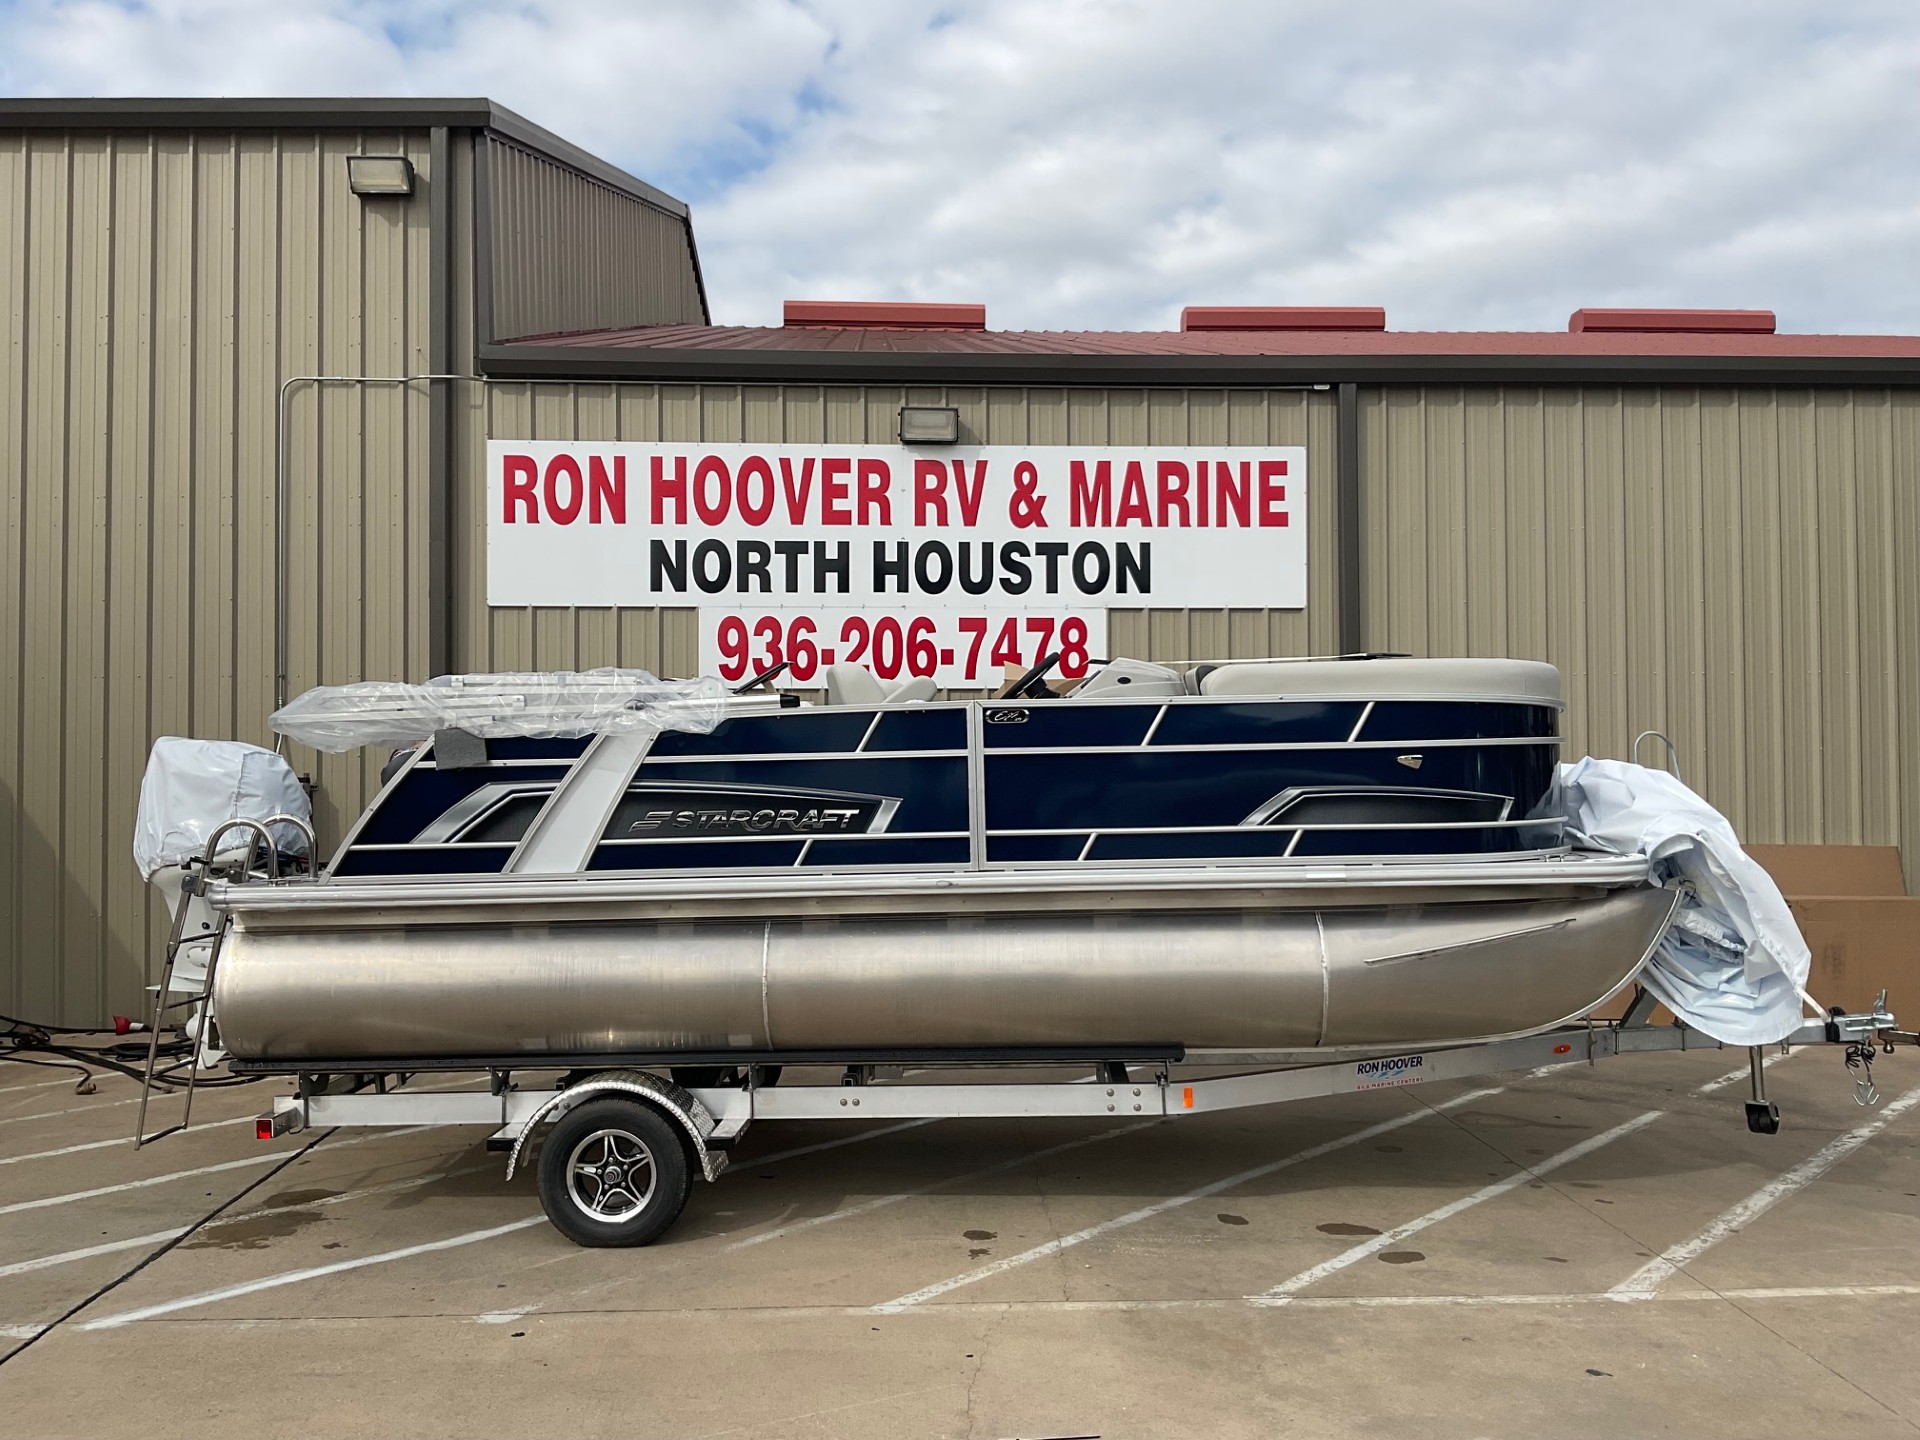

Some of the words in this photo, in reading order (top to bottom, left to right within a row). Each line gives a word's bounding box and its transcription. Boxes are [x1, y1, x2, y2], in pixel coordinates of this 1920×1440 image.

[503, 454, 626, 526] RON
[650, 456, 892, 527] HOOVER
[914, 459, 988, 527] RV
[1010, 460, 1048, 528] &
[1069, 460, 1289, 528] MARINE
[650, 538, 850, 594] NORTH
[872, 540, 1152, 595] HOUSTON
[717, 615, 1089, 681] 936-206-7478
[672, 809, 859, 831] STARCRAFT
[1357, 1062, 1379, 1074] RON
[1381, 1056, 1423, 1071] HOOVER
